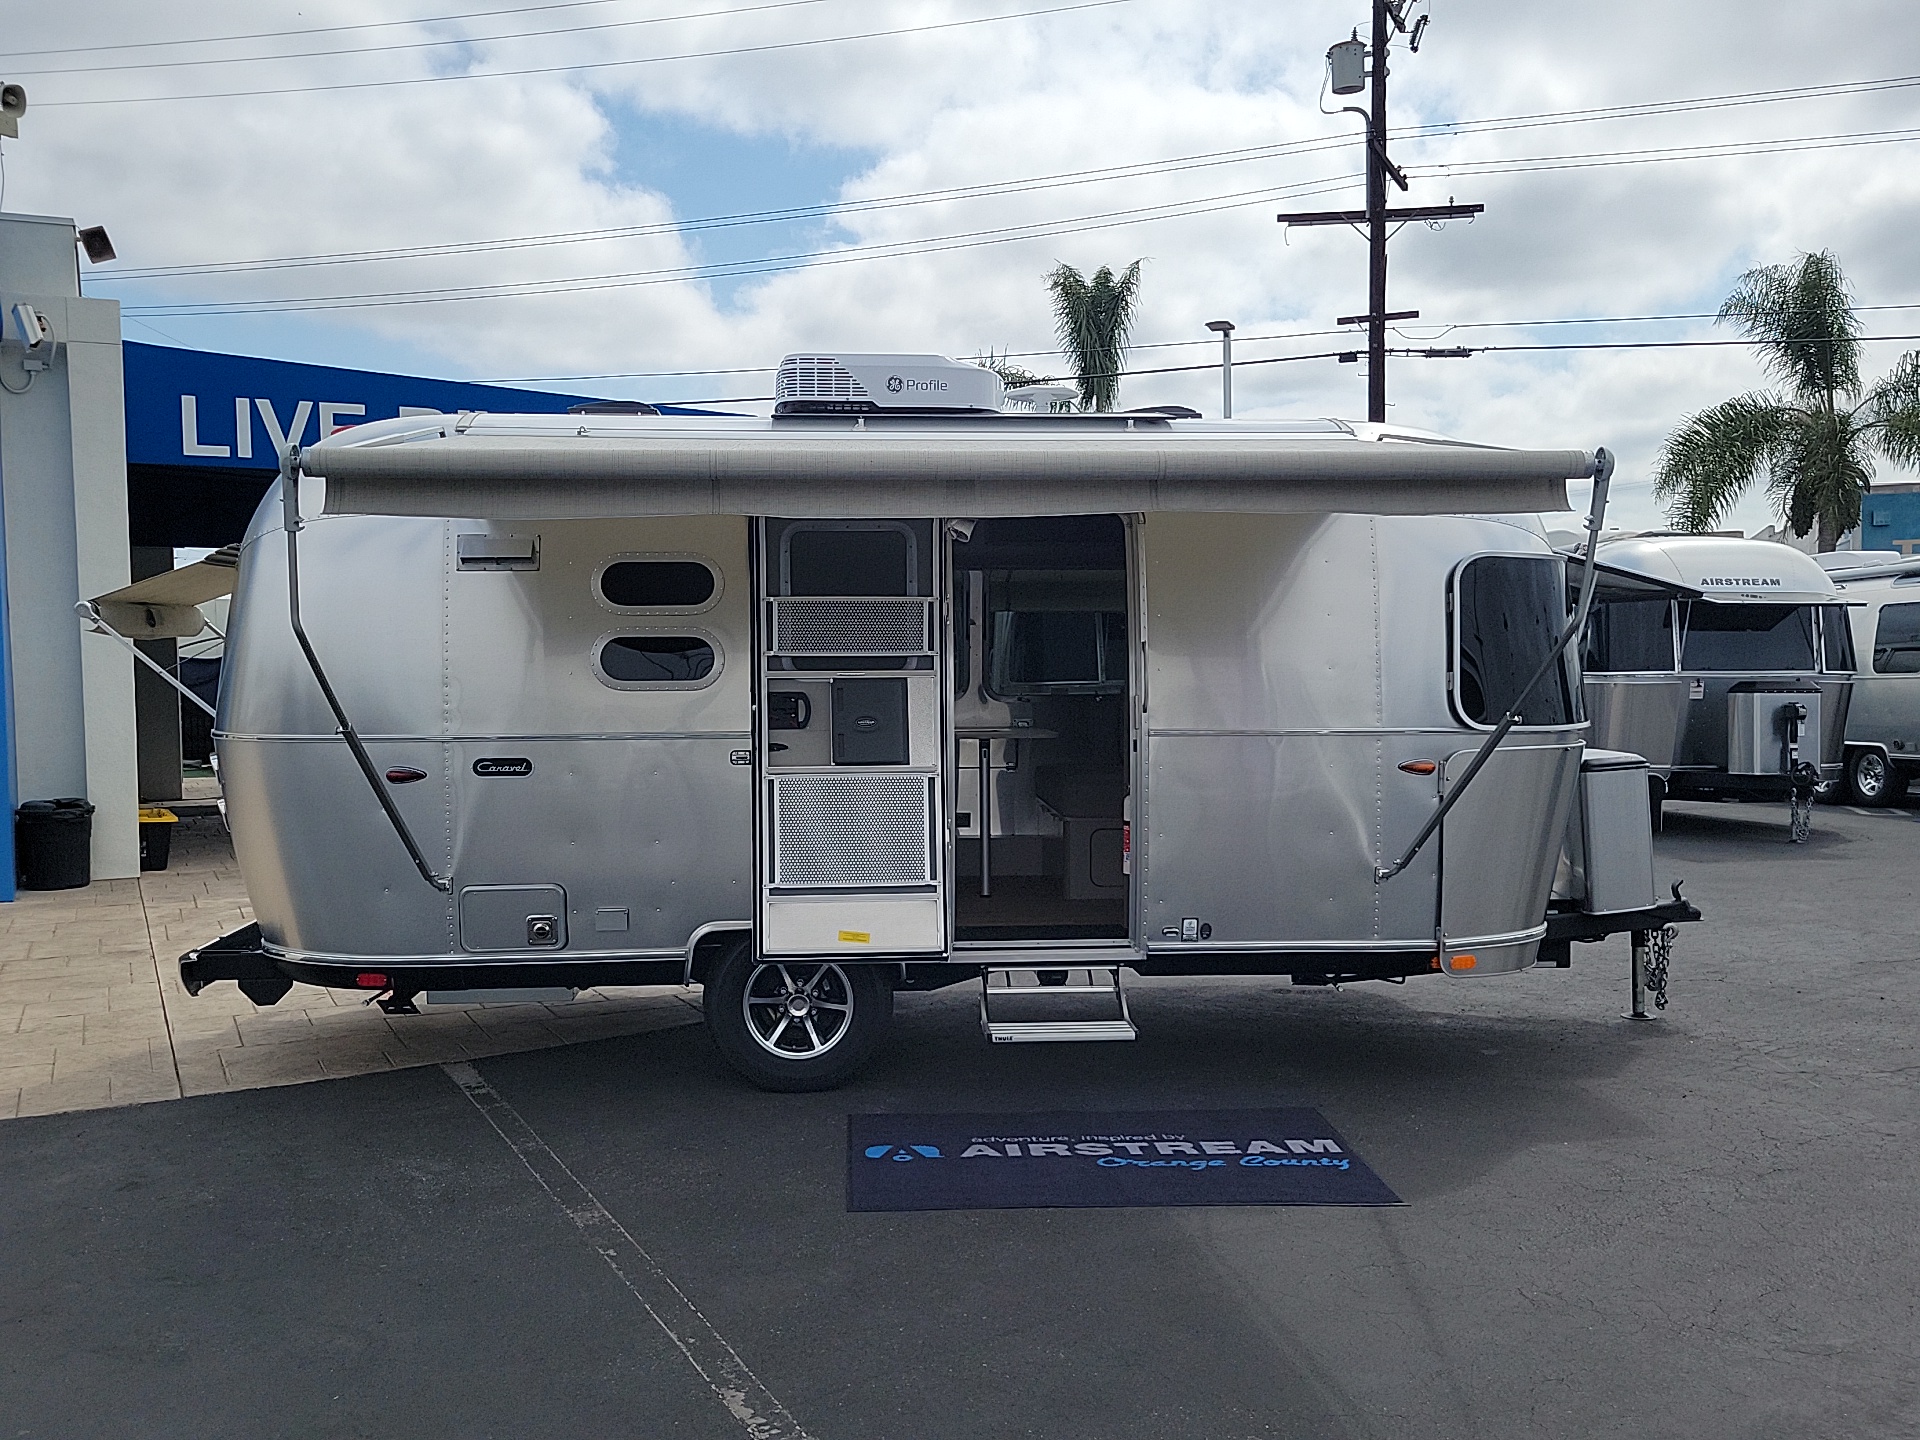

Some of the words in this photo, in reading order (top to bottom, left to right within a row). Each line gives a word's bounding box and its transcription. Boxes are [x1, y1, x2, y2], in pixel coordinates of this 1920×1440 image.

[906, 379, 949, 391] Profile
[1700, 577, 1781, 587] AIRSTREAM
[476, 761, 530, 772] Caravel
[1081, 1133, 1158, 1142] inspired
[1161, 1133, 1186, 1141] by
[959, 1138, 1344, 1159] AIRSTREAM
[1096, 1156, 1227, 1171] Orange
[1238, 1155, 1350, 1171] County
